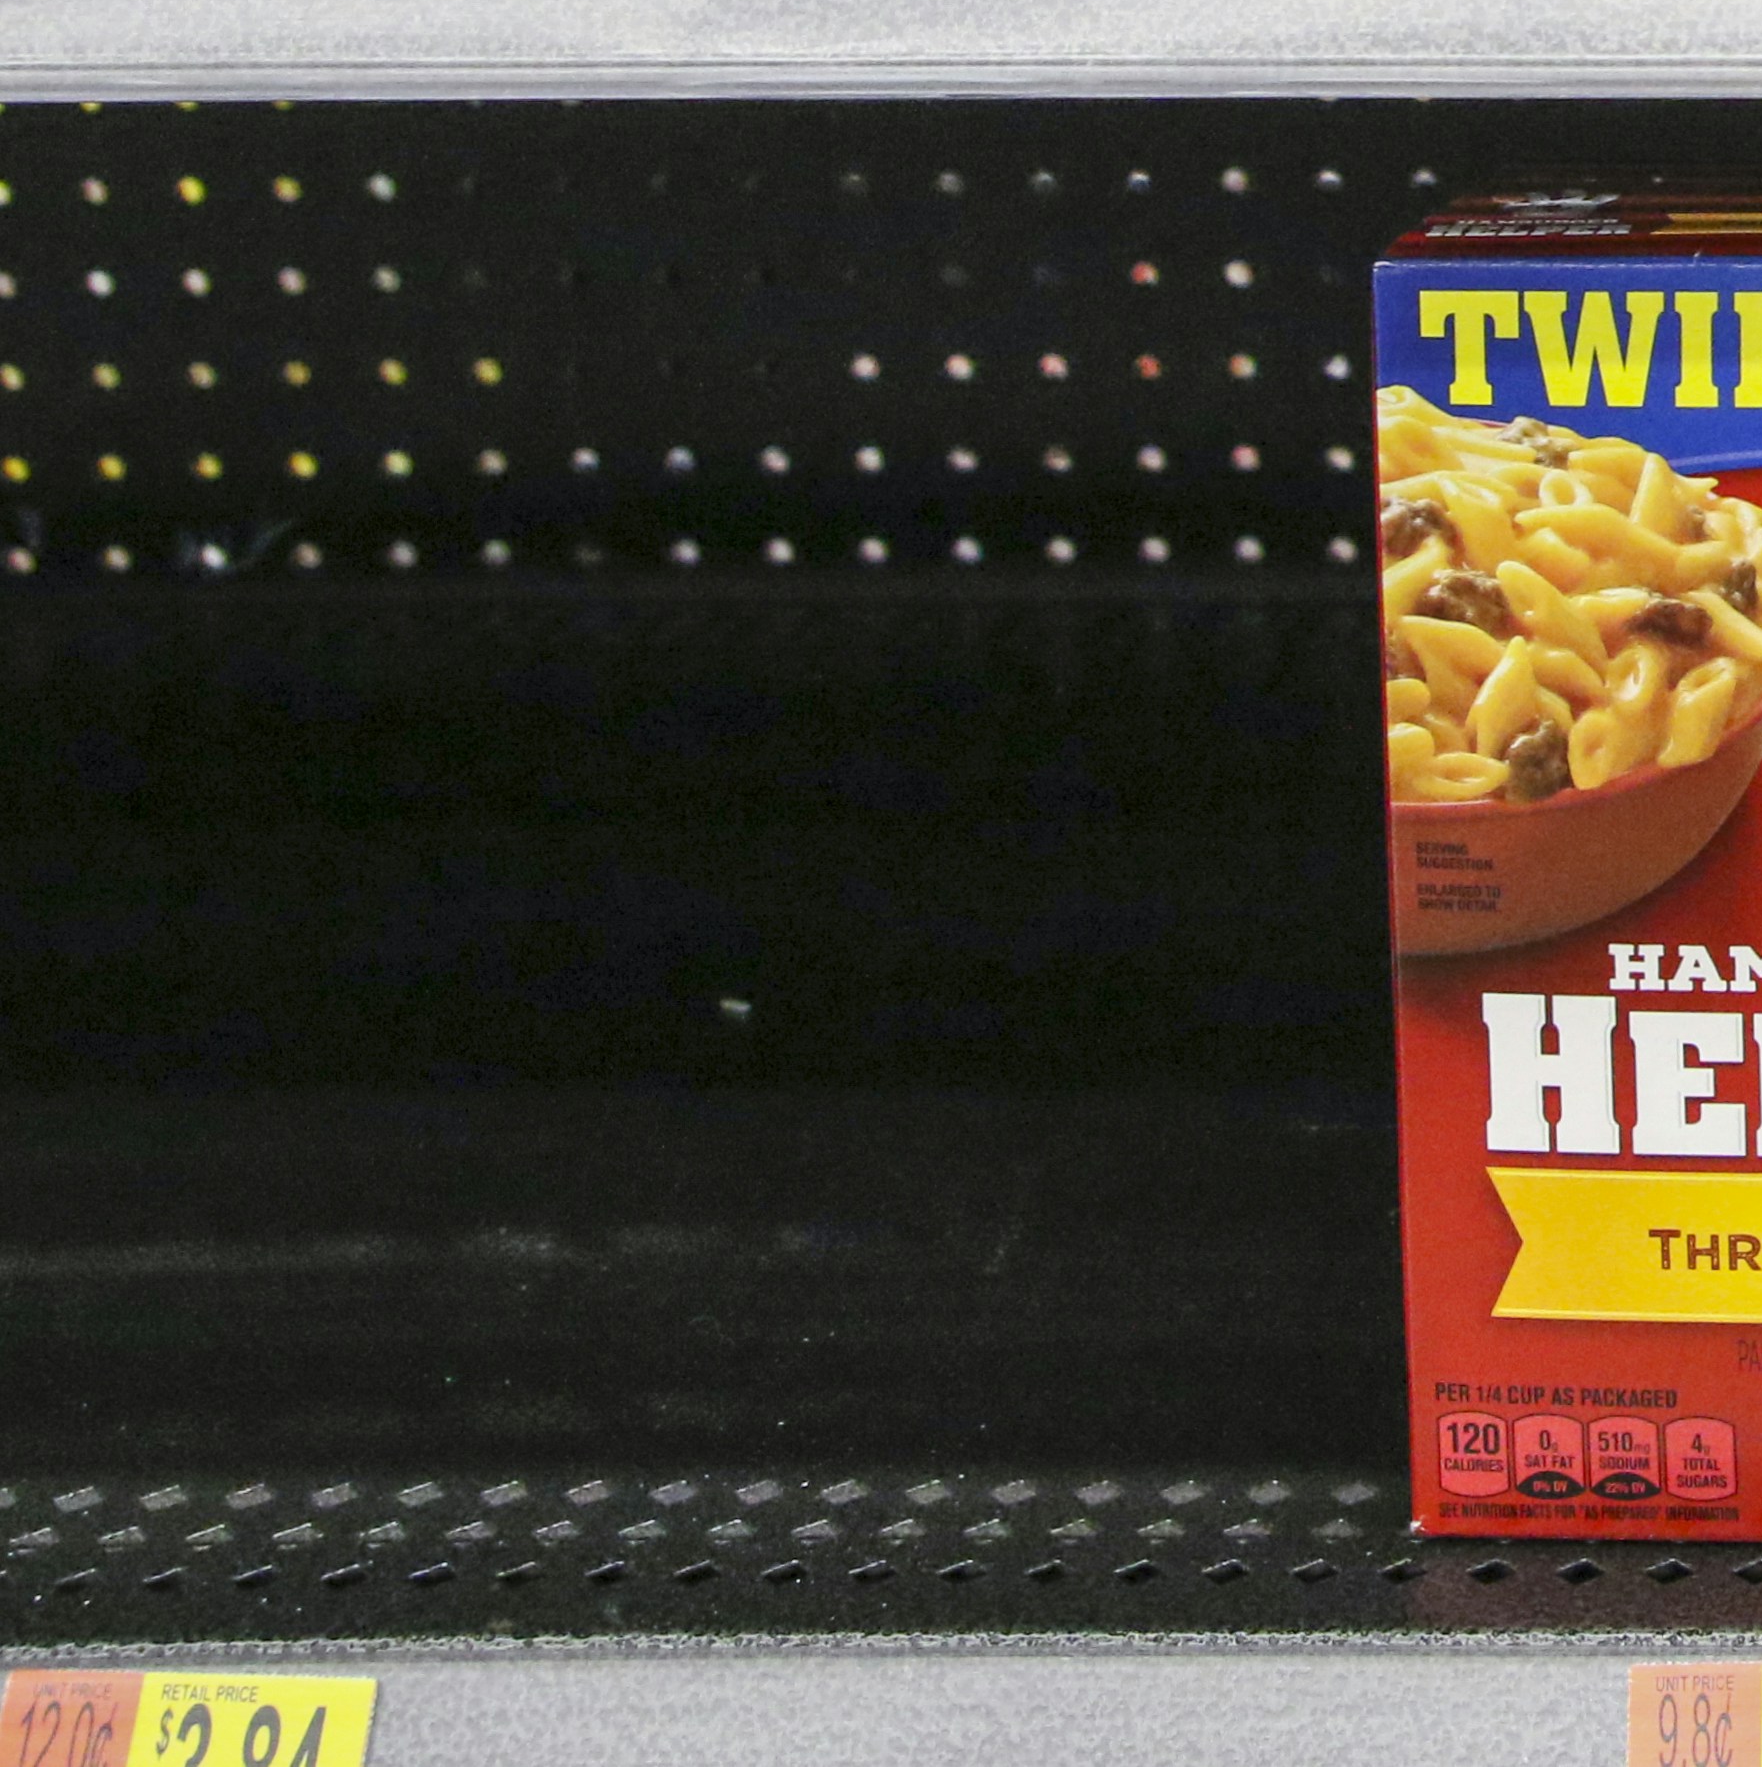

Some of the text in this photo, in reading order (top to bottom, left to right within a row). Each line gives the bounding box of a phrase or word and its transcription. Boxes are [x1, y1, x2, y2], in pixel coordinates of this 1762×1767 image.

[1435, 1382, 1678, 1408] PER 1/4 CUP AS PACKAGED
[1447, 1422, 1501, 1455] 120
[1443, 1457, 1504, 1473] CALORIES
[1524, 1454, 1575, 1469] SAT FAT
[1598, 1456, 1650, 1470] SODIUM
[1681, 1457, 1721, 1471] TOTAL
[1676, 1474, 1727, 1489] SUGARS
[1656, 1675, 1734, 1691] UNIT PRICE
[161, 1683, 260, 1703] RETAIL PRICE
